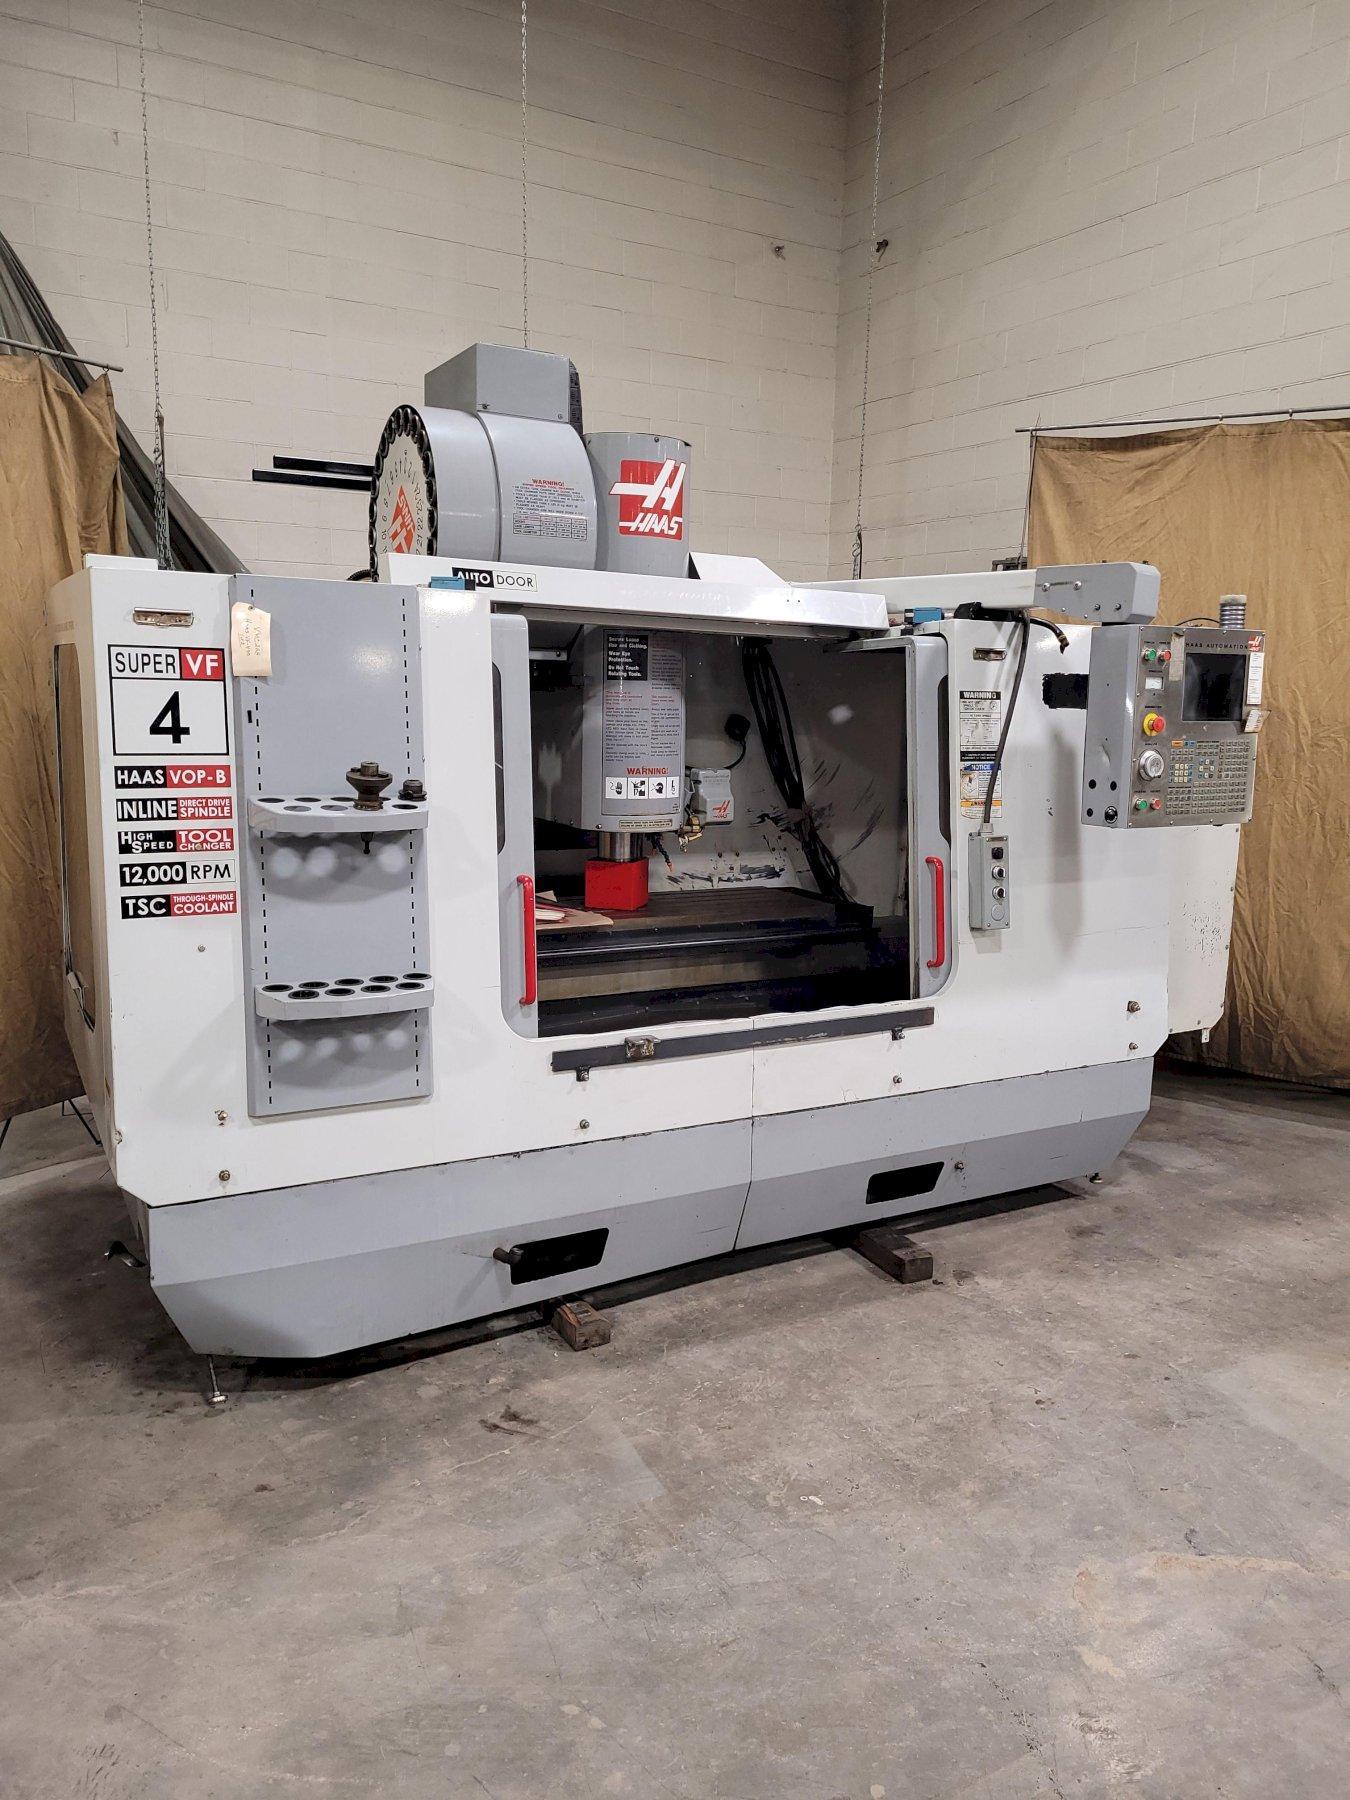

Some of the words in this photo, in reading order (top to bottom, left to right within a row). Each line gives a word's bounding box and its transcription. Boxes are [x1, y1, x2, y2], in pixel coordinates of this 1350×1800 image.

[619, 512, 683, 535] HAAS
[497, 575, 534, 587] DOOR
[115, 652, 177, 675] SUPER
[185, 653, 219, 676] VF
[963, 691, 997, 699] WARNING
[149, 691, 191, 744] 4
[117, 769, 165, 785] HAAS
[169, 768, 227, 784] VOP-B
[627, 767, 669, 775] WARNING!
[117, 800, 178, 819] INLINE
[179, 799, 206, 807] DIRECT
[208, 799, 230, 807] DRIVE
[180, 806, 231, 817] SPINDLE
[179, 830, 232, 843] TOOL
[179, 841, 232, 851] CHNGER
[122, 865, 184, 885] 12,000
[191, 864, 231, 880] RPM
[173, 893, 234, 903] THROUGH-SPINDLE
[125, 897, 167, 916] TSC
[174, 901, 234, 914] COOLANT
